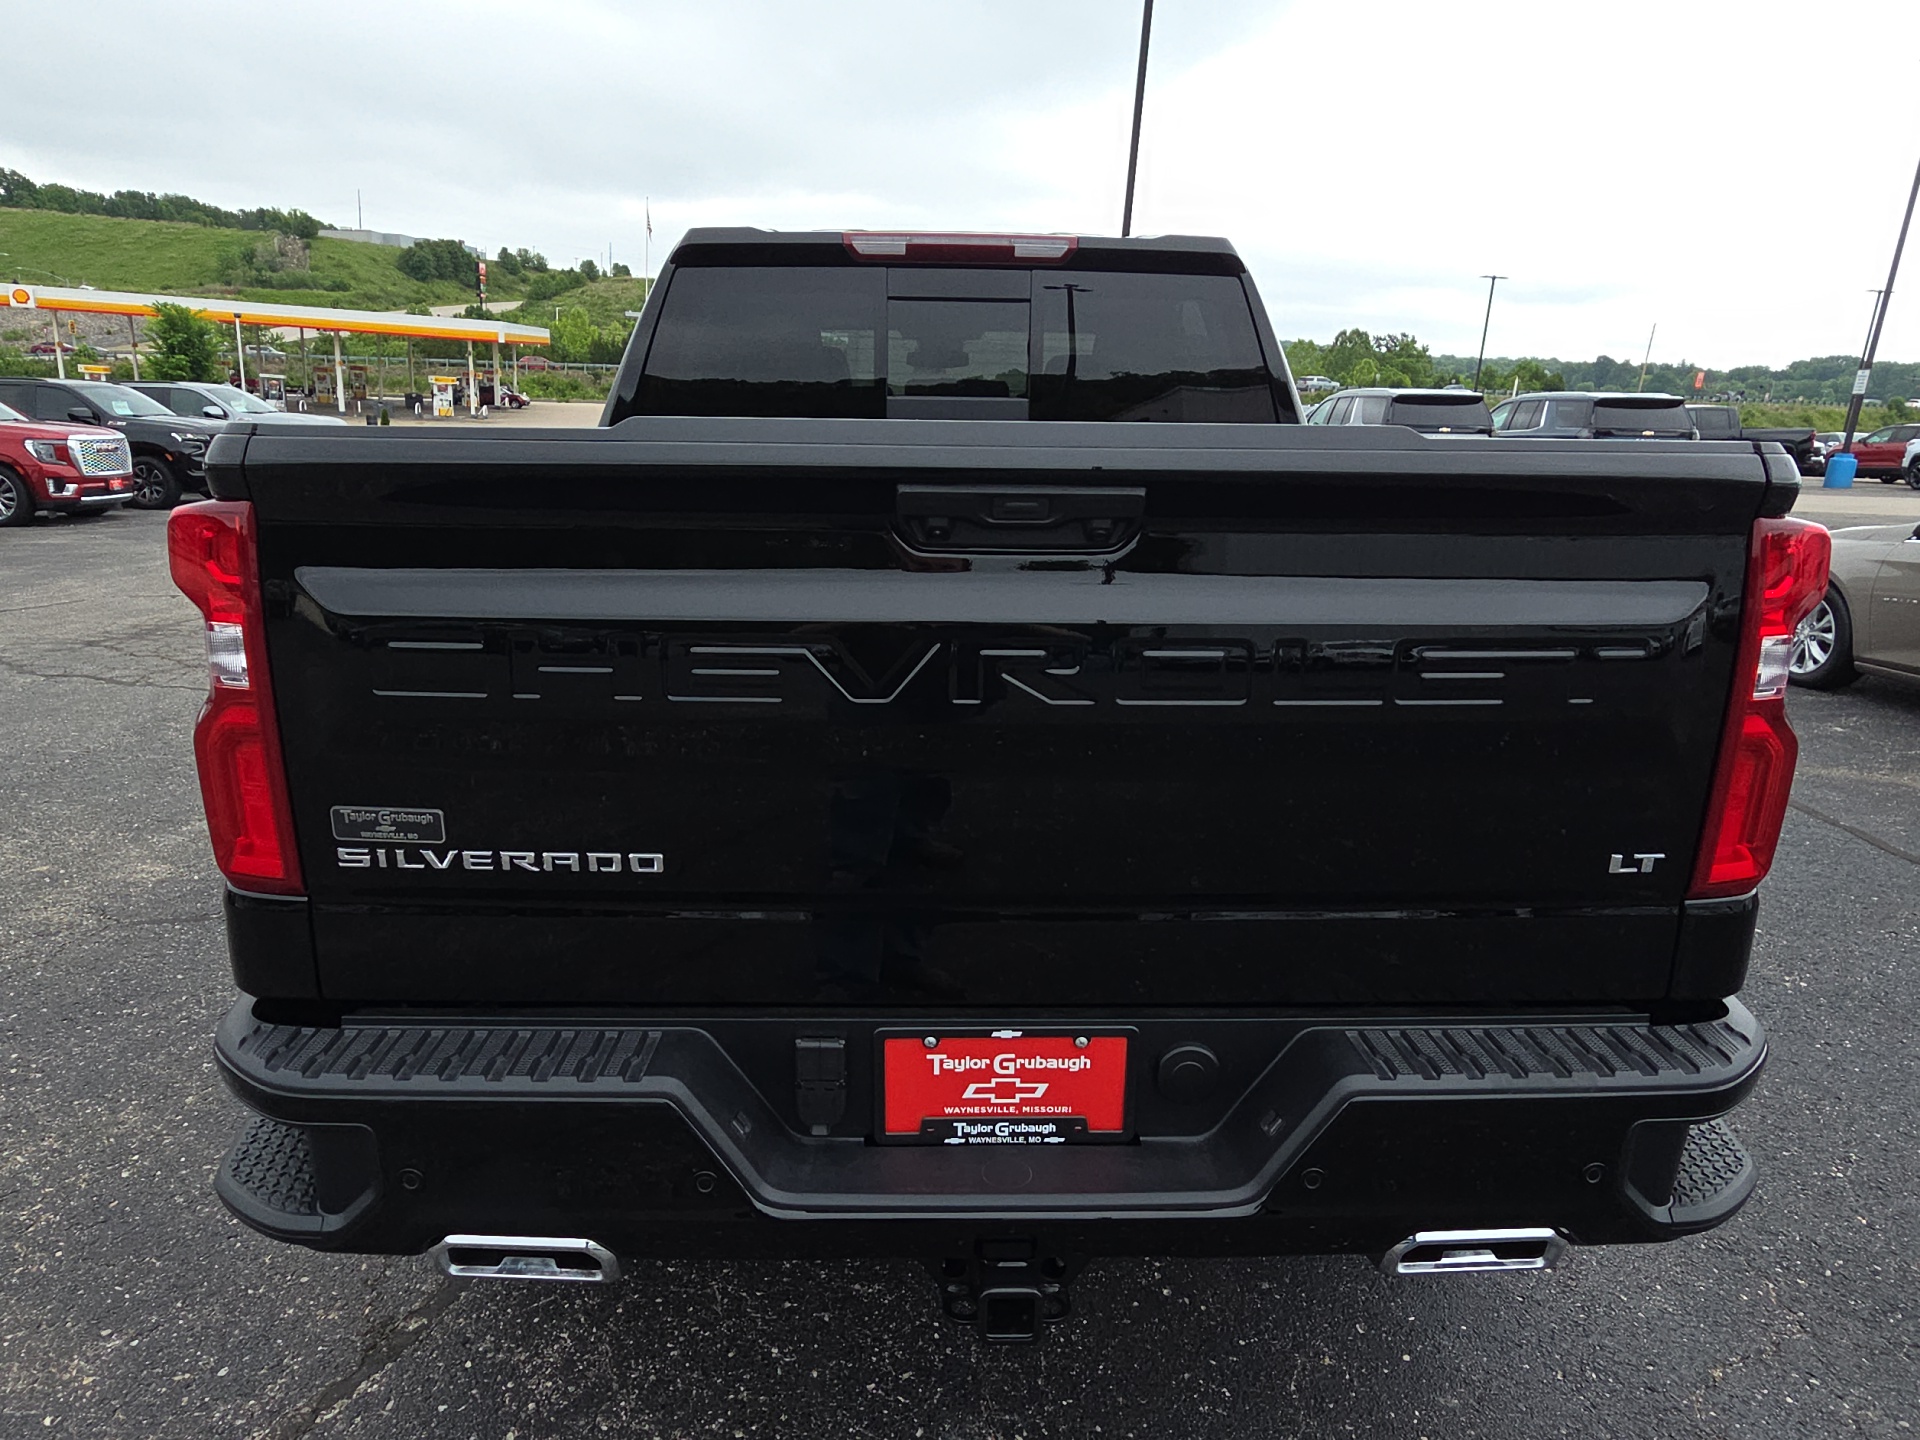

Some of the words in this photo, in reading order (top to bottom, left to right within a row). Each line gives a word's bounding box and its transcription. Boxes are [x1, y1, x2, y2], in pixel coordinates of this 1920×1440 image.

[366, 634, 1652, 707] CHEVROLET
[339, 809, 377, 824] Taylor
[377, 810, 434, 825] Grubaugh
[337, 847, 664, 873] SILVERADO
[1608, 853, 1666, 873] LT
[926, 1054, 990, 1075] Taylor
[993, 1053, 1091, 1075] Grubaugh
[943, 1106, 1020, 1115] WAYNESVILLE,
[1022, 1105, 1072, 1114] MISSOURI
[953, 1122, 994, 1137] Taylor
[994, 1121, 1057, 1136] Grubaugh
[968, 1136, 1027, 1145] WAYNESVILLE,
[1028, 1136, 1042, 1144] MO
